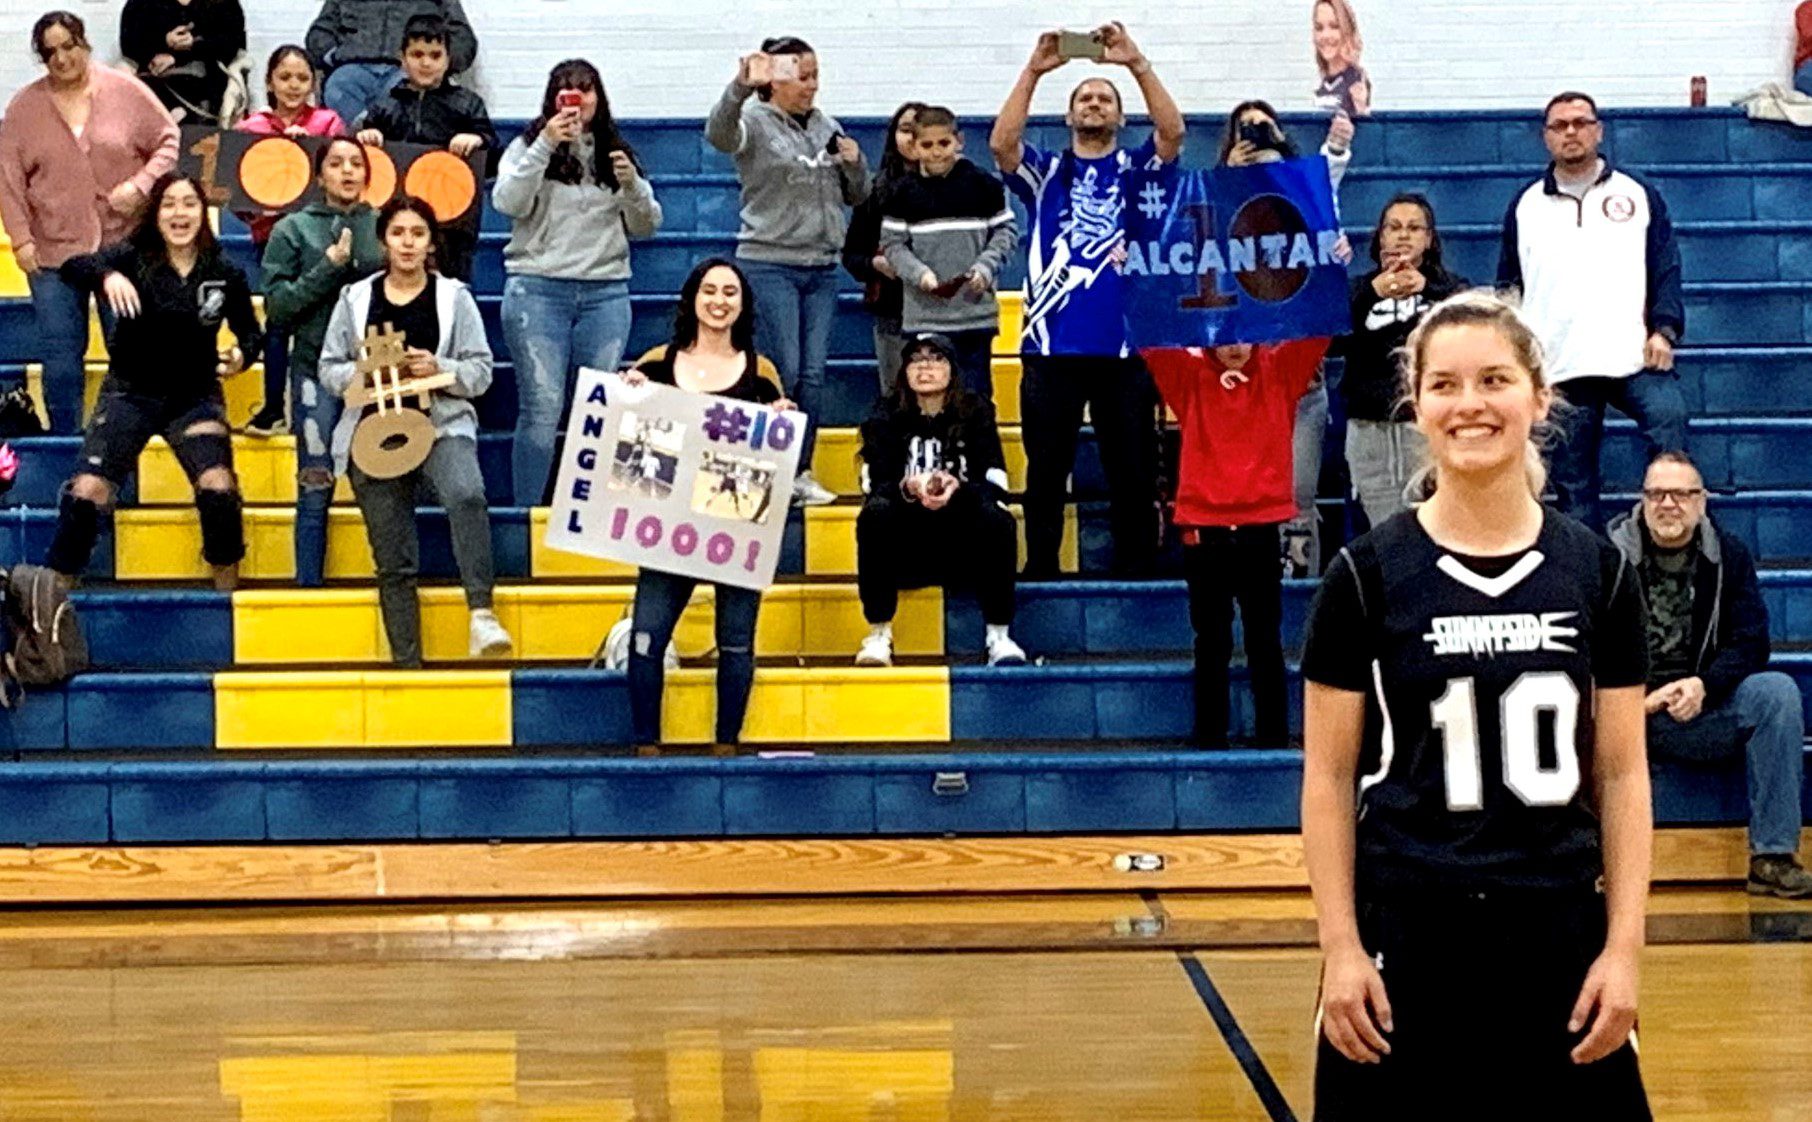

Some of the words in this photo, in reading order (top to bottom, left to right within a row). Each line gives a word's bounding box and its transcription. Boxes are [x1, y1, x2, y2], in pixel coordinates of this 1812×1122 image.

[1123, 230, 1341, 276] ALCANTAR
[702, 402, 796, 451] #10
[567, 383, 607, 534] ANGEL
[611, 507, 761, 572] 1000!
[1423, 611, 1579, 660] SUNNYSIDE
[1430, 671, 1580, 812] 10
